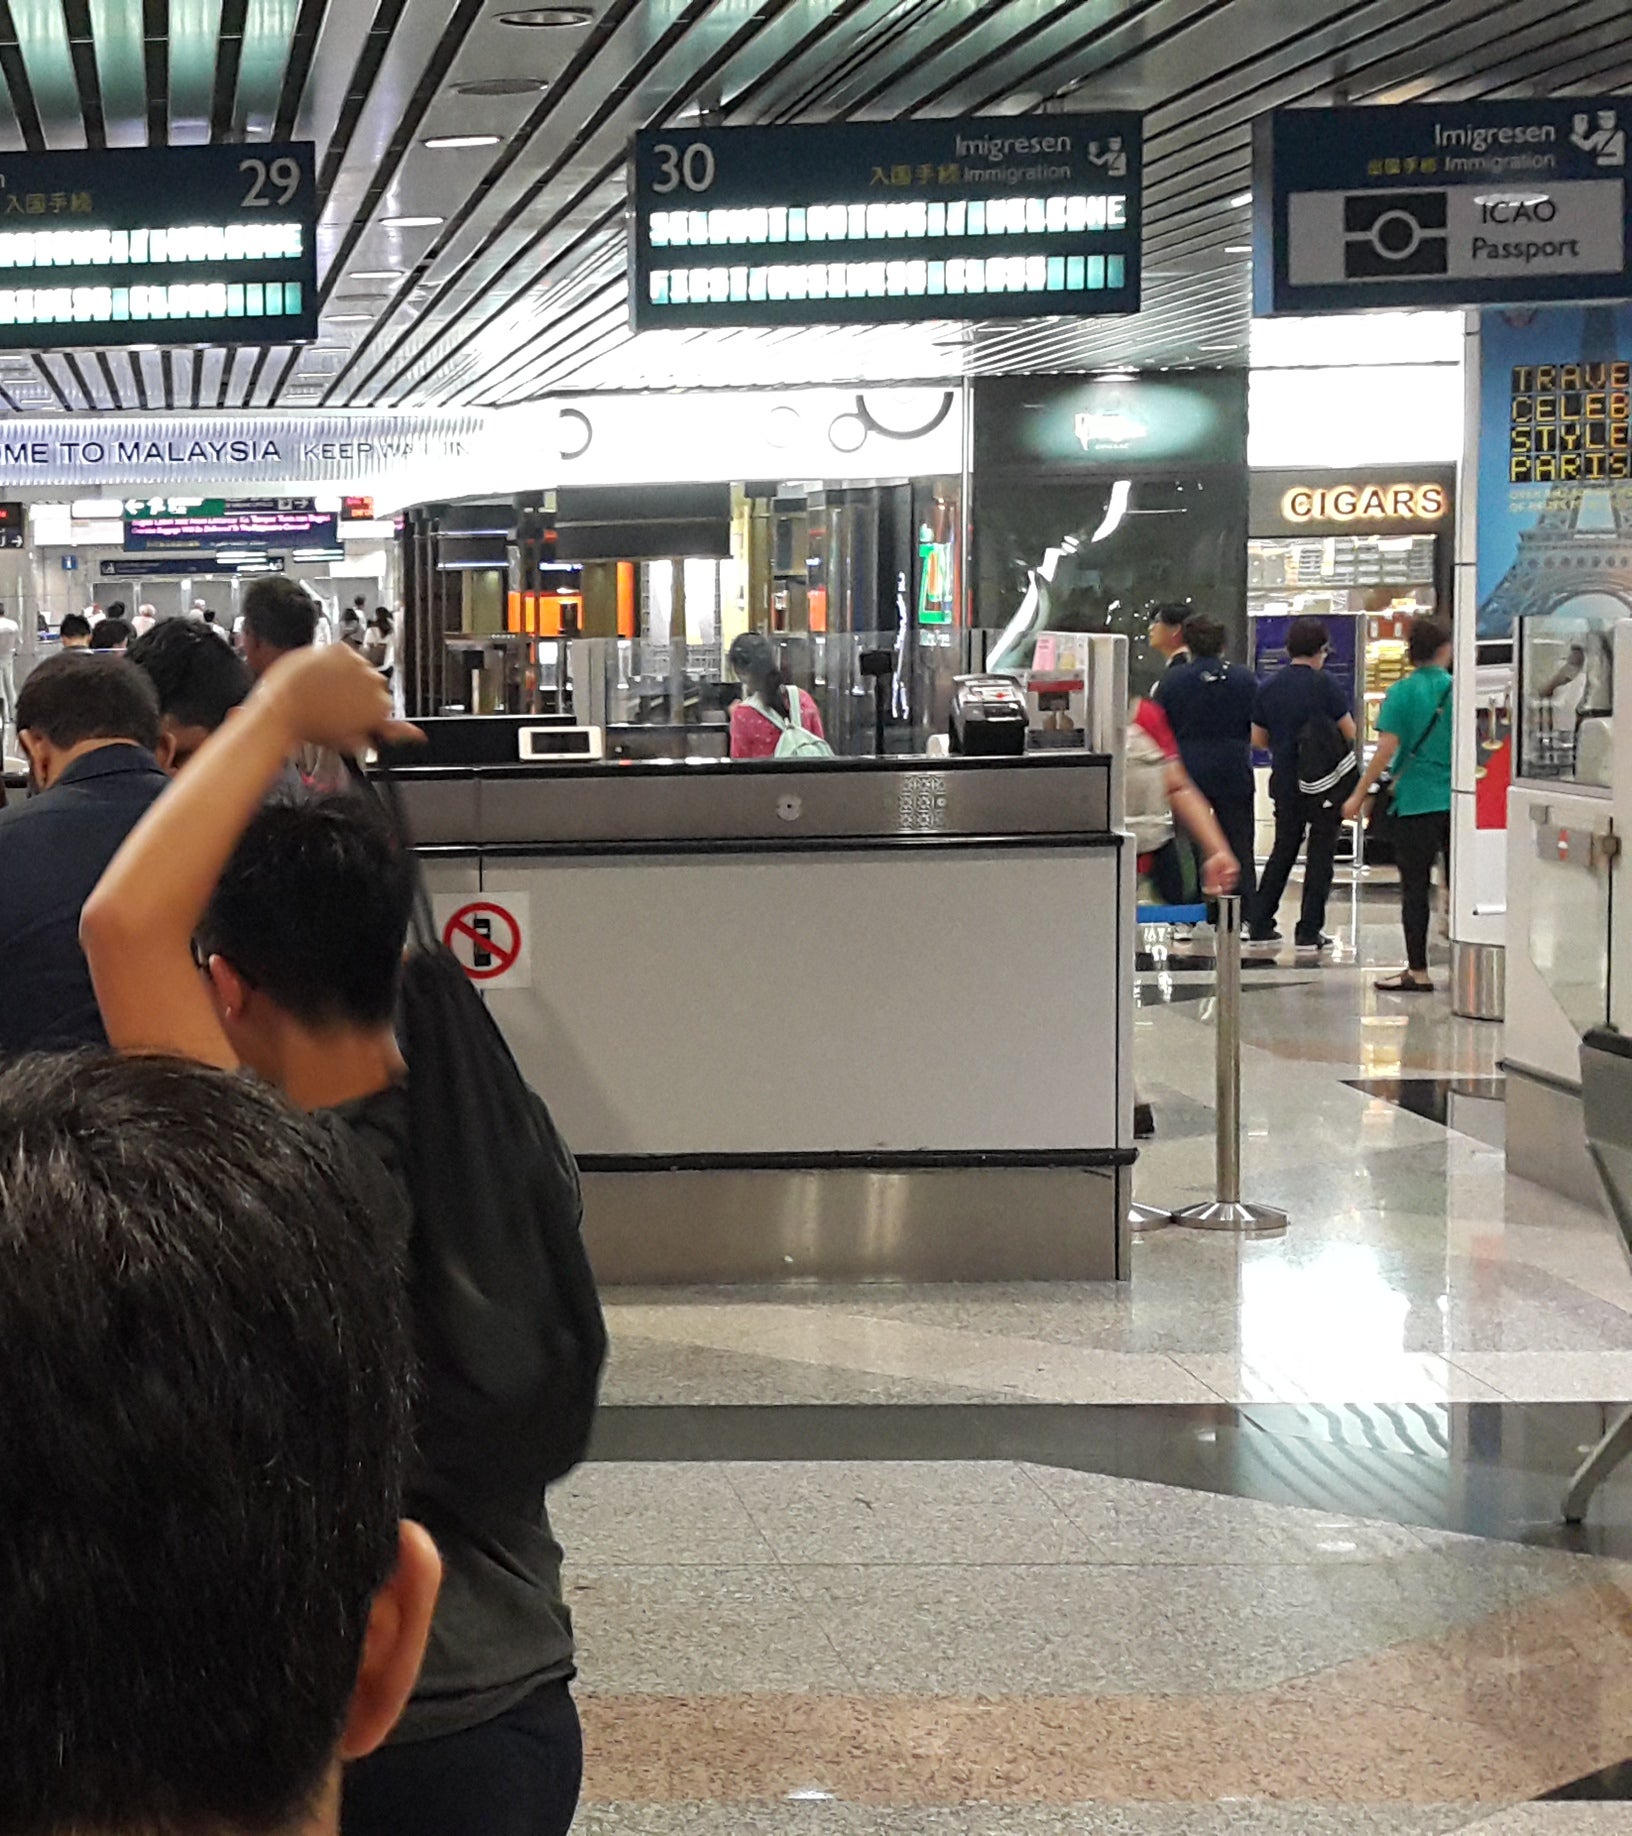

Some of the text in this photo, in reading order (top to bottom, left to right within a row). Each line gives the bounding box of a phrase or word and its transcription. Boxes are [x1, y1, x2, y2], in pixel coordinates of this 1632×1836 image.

[955, 134, 1071, 161] Imigresen
[1434, 123, 1557, 150] Imigresen
[652, 142, 715, 193] 30
[964, 164, 1071, 184] Immigration
[1444, 153, 1557, 175] Immigration
[239, 156, 301, 207] 29
[1482, 200, 1556, 225] ICAO
[1472, 236, 1580, 265] Passport
[1511, 423, 1629, 453] STYLE
[59, 441, 104, 464] TO
[118, 440, 282, 463] MALAYSIA
[304, 442, 373, 460] KEEP
[1510, 453, 1628, 482] PARIS
[1290, 488, 1442, 516] CIGARS
